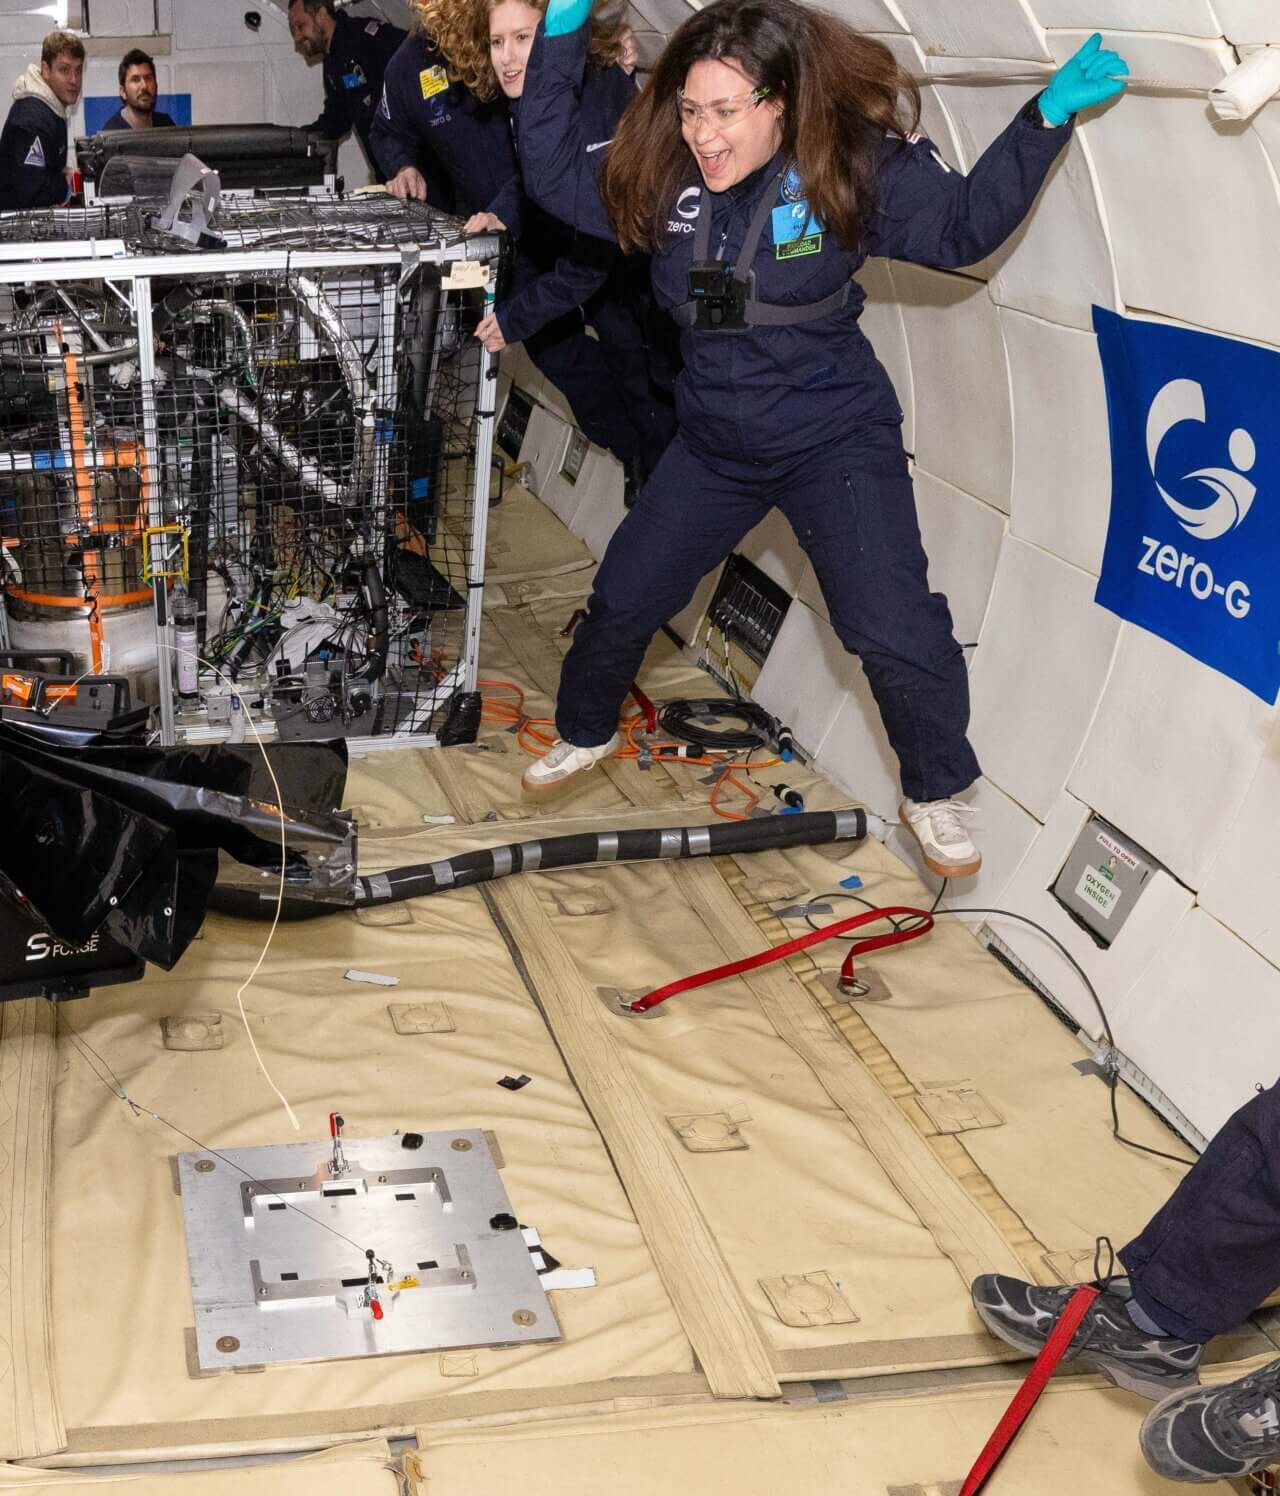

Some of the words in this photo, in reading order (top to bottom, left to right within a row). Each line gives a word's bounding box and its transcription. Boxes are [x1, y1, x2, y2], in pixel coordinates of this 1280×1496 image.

[667, 220, 696, 233] zero-
[1137, 535, 1251, 619] zero-G
[1099, 835, 1112, 849] PULL
[1113, 846, 1121, 855] TO
[1120, 852, 1137, 866] OPEN
[1083, 884, 1108, 908] INSIDE
[1086, 874, 1116, 900] OXYGEN
[52, 938, 100, 958] FOGE
